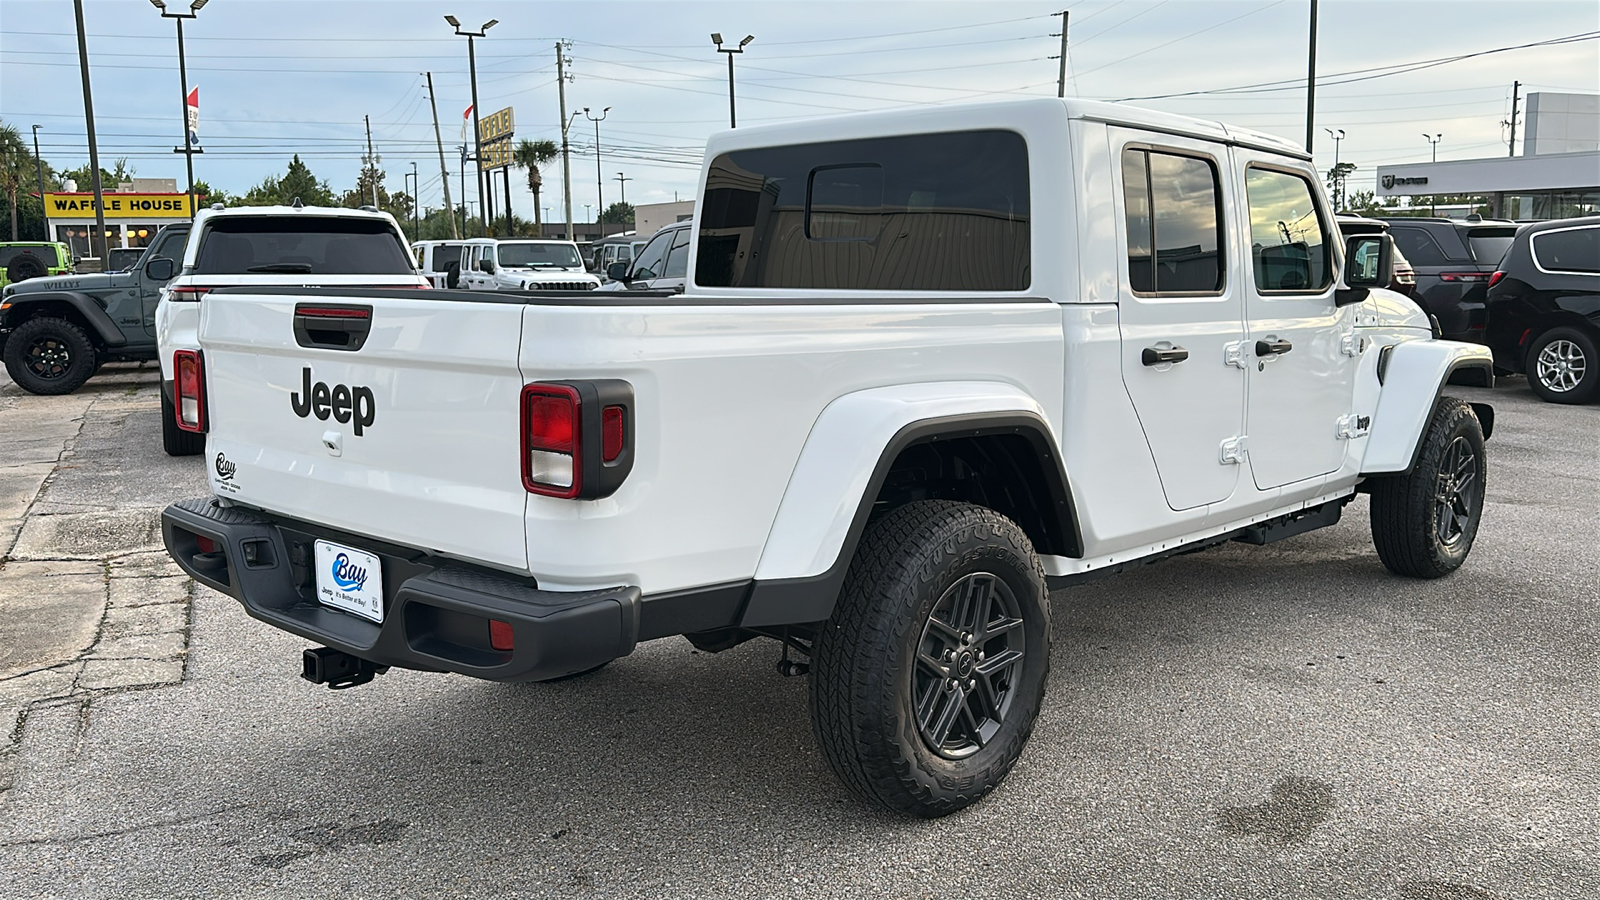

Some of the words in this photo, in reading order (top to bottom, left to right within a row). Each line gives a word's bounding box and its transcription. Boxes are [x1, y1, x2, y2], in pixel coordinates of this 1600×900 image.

[130, 200, 182, 210] HOUSE
[43, 281, 80, 290] WILLYS
[291, 367, 375, 437] Jeep
[215, 452, 237, 479] Bay
[334, 552, 368, 591] Bay
